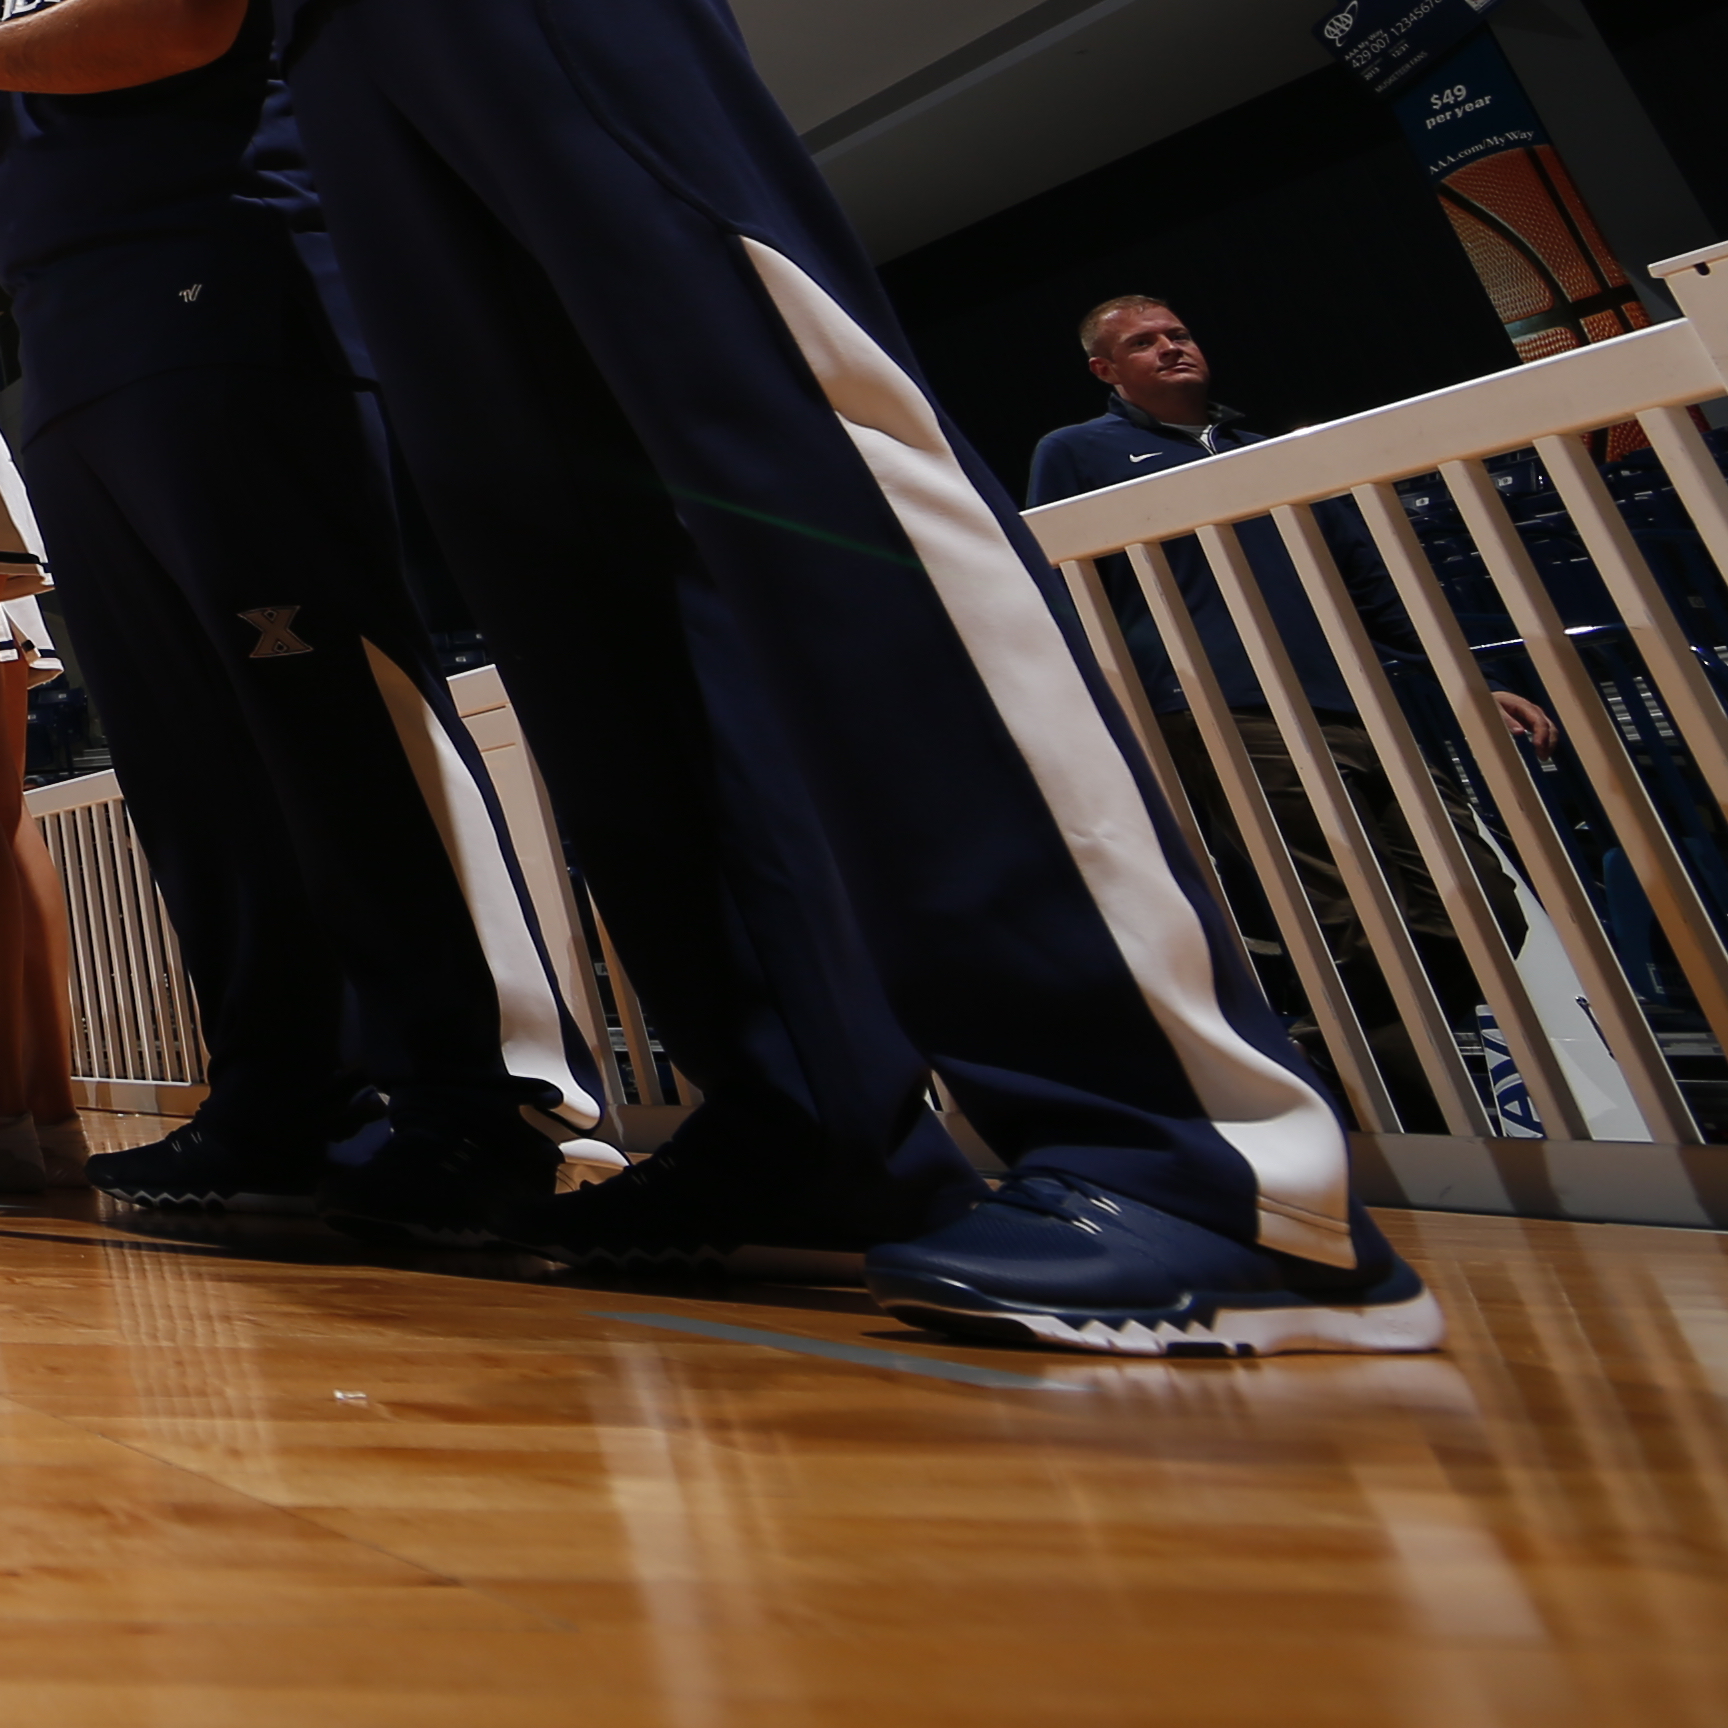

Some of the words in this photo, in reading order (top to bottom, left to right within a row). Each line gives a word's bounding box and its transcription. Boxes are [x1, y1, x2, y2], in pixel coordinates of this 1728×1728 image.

[1351, 50, 1372, 69] 429
[1370, 33, 1391, 53] 007
[1425, 111, 1453, 130] per
[1454, 95, 1493, 119] year
[1430, 84, 1467, 110] $49
